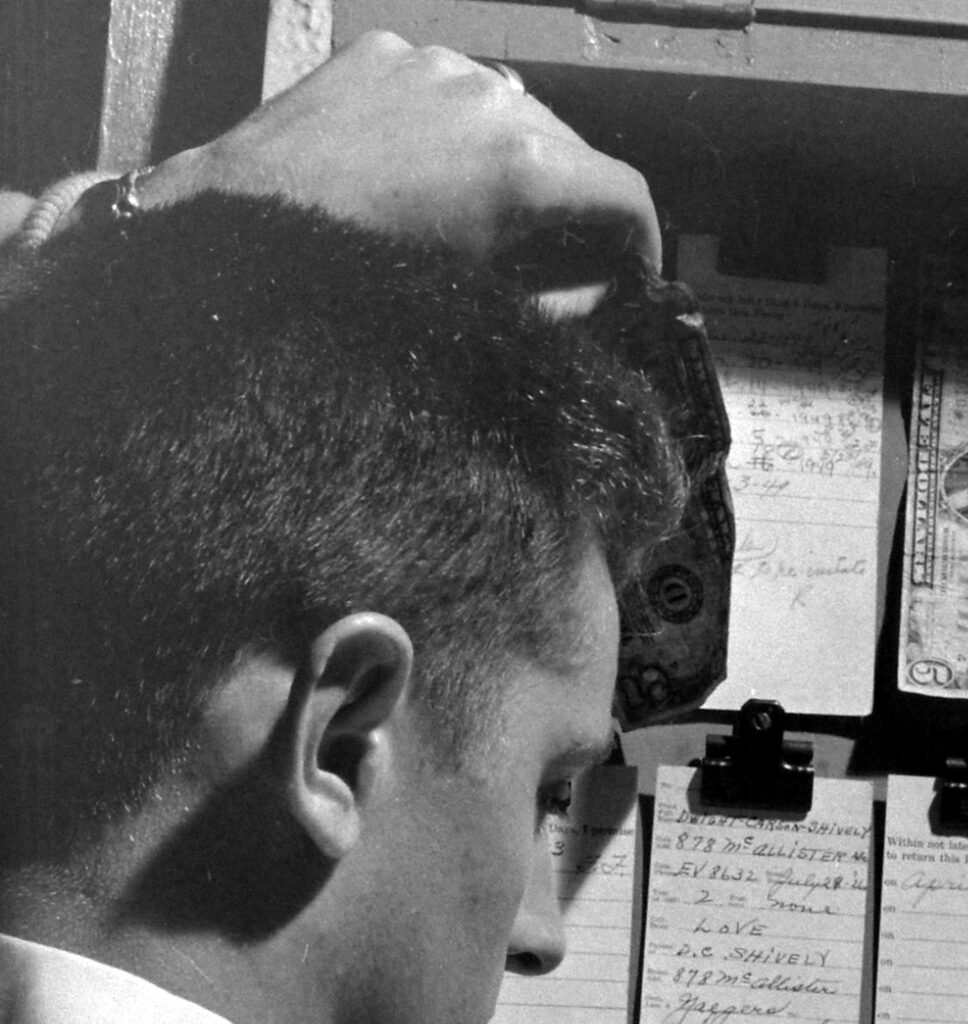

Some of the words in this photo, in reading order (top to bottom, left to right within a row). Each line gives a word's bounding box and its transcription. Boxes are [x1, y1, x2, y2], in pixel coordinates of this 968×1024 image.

[908, 659, 952, 688] 5
[677, 832, 716, 853] 878
[887, 836, 925, 849] Within
[927, 840, 945, 850] not
[886, 850, 898, 861] to
[901, 852, 936, 864] return
[939, 853, 961, 865] this
[672, 967, 714, 988] 878
